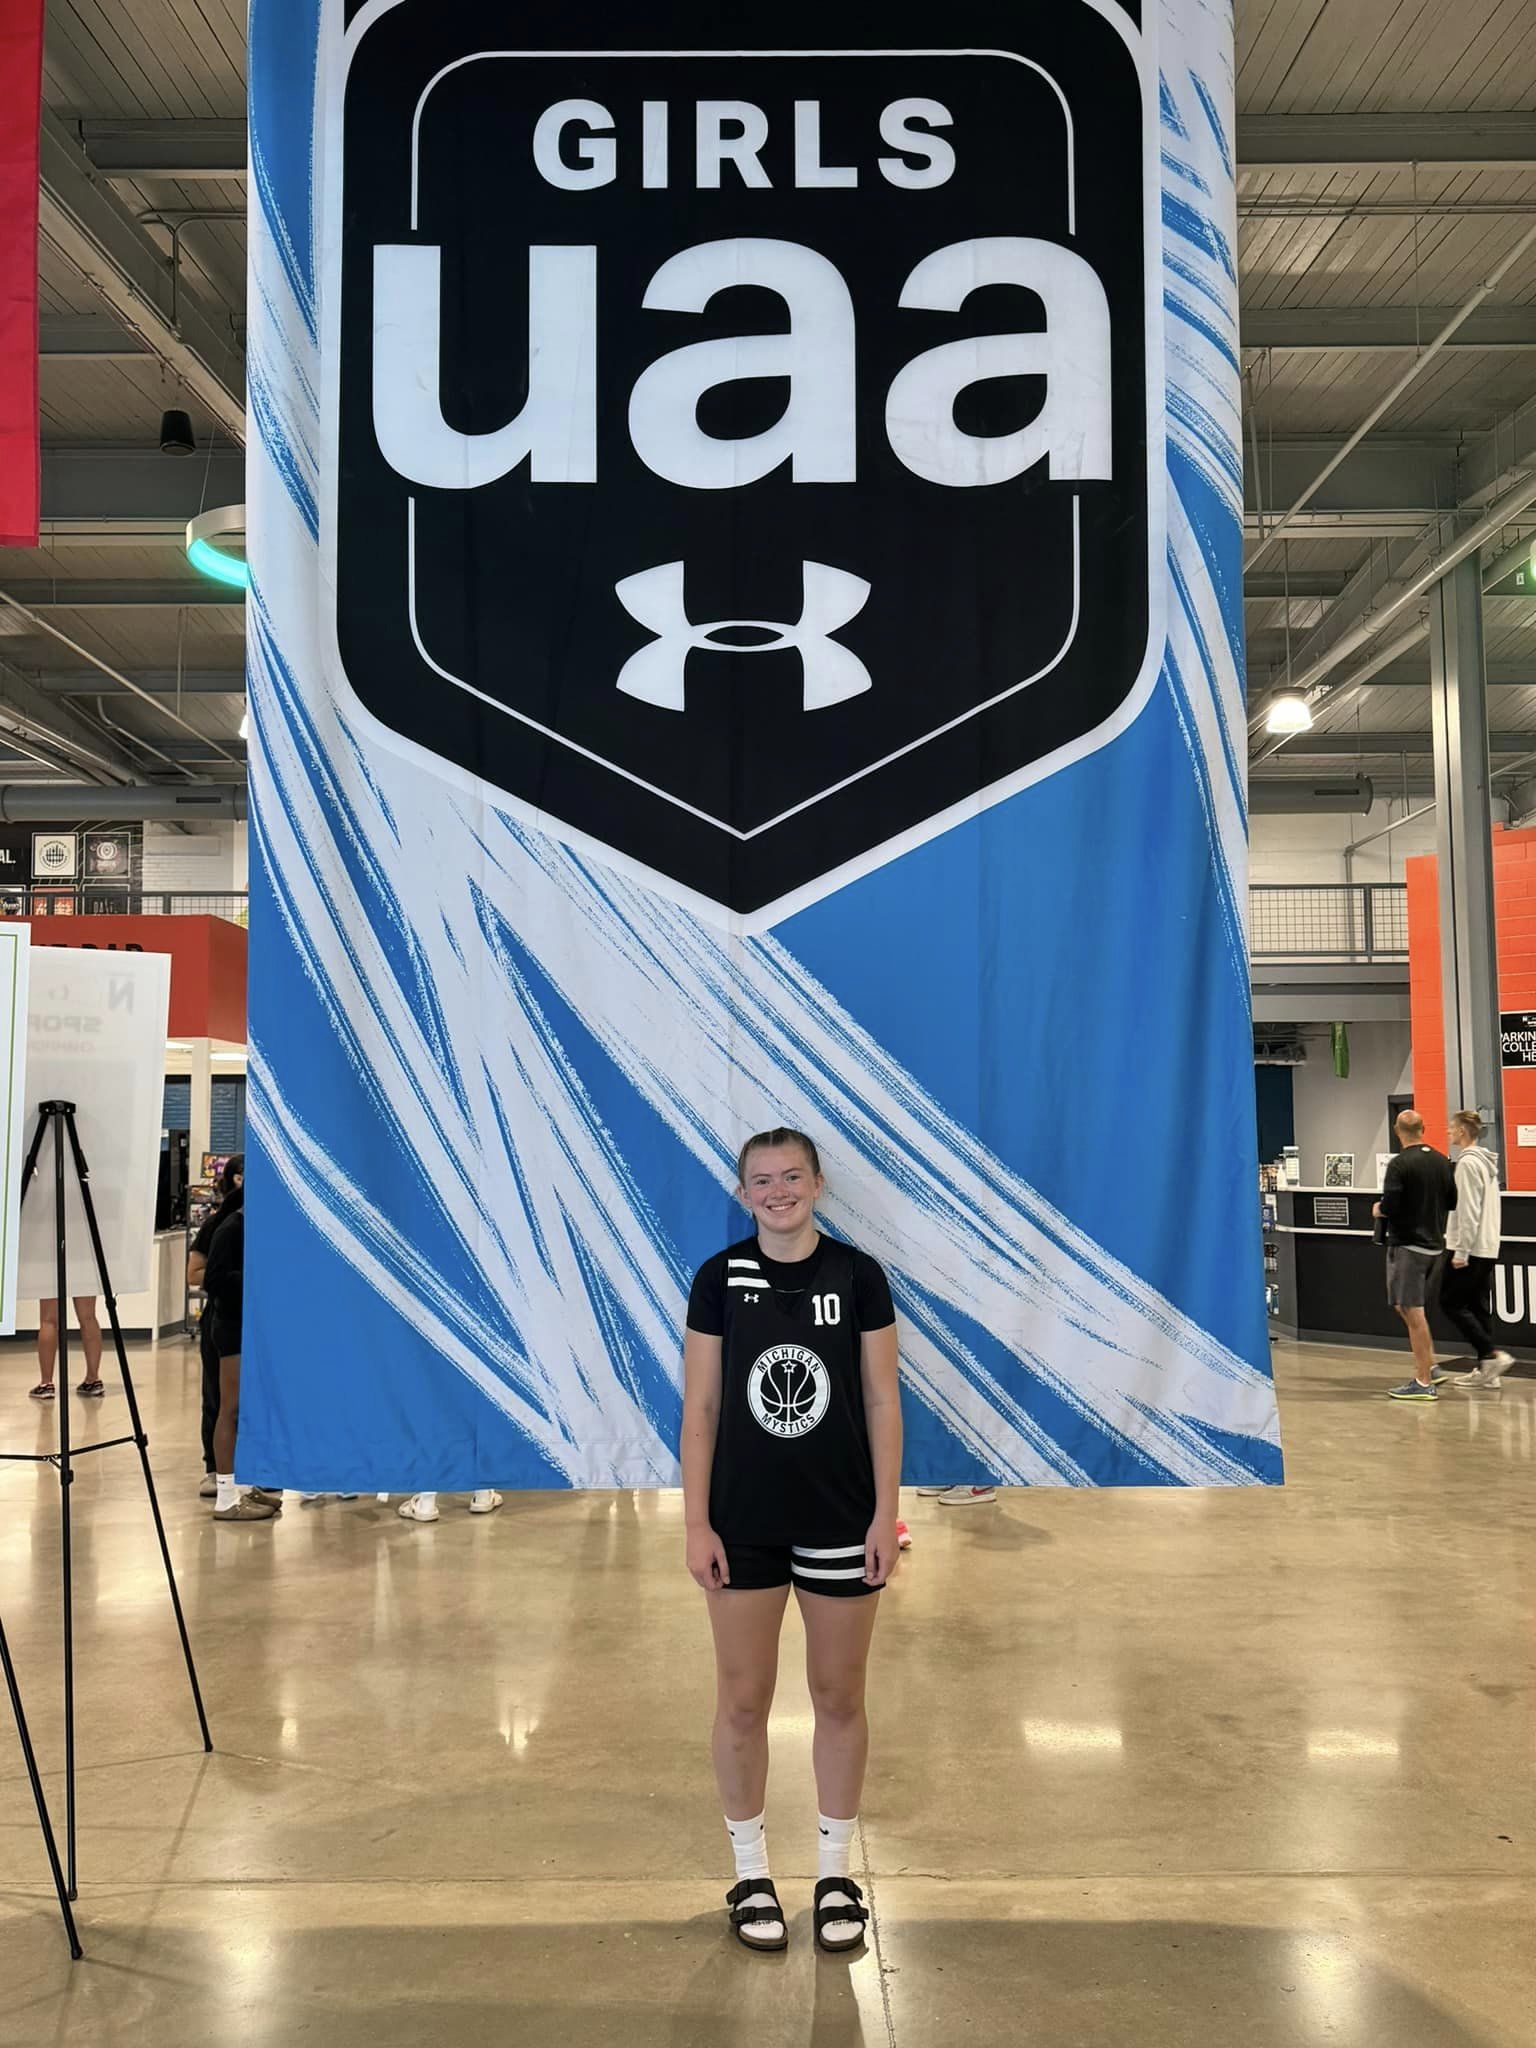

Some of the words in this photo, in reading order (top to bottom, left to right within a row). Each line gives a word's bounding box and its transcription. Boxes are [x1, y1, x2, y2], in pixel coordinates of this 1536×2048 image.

[534, 98, 955, 190] GIRLS
[373, 237, 1112, 489] uaa
[812, 1294, 840, 1325] 10
[757, 1348, 821, 1373] MICHIGAN
[761, 1413, 816, 1433] MYSTICS
